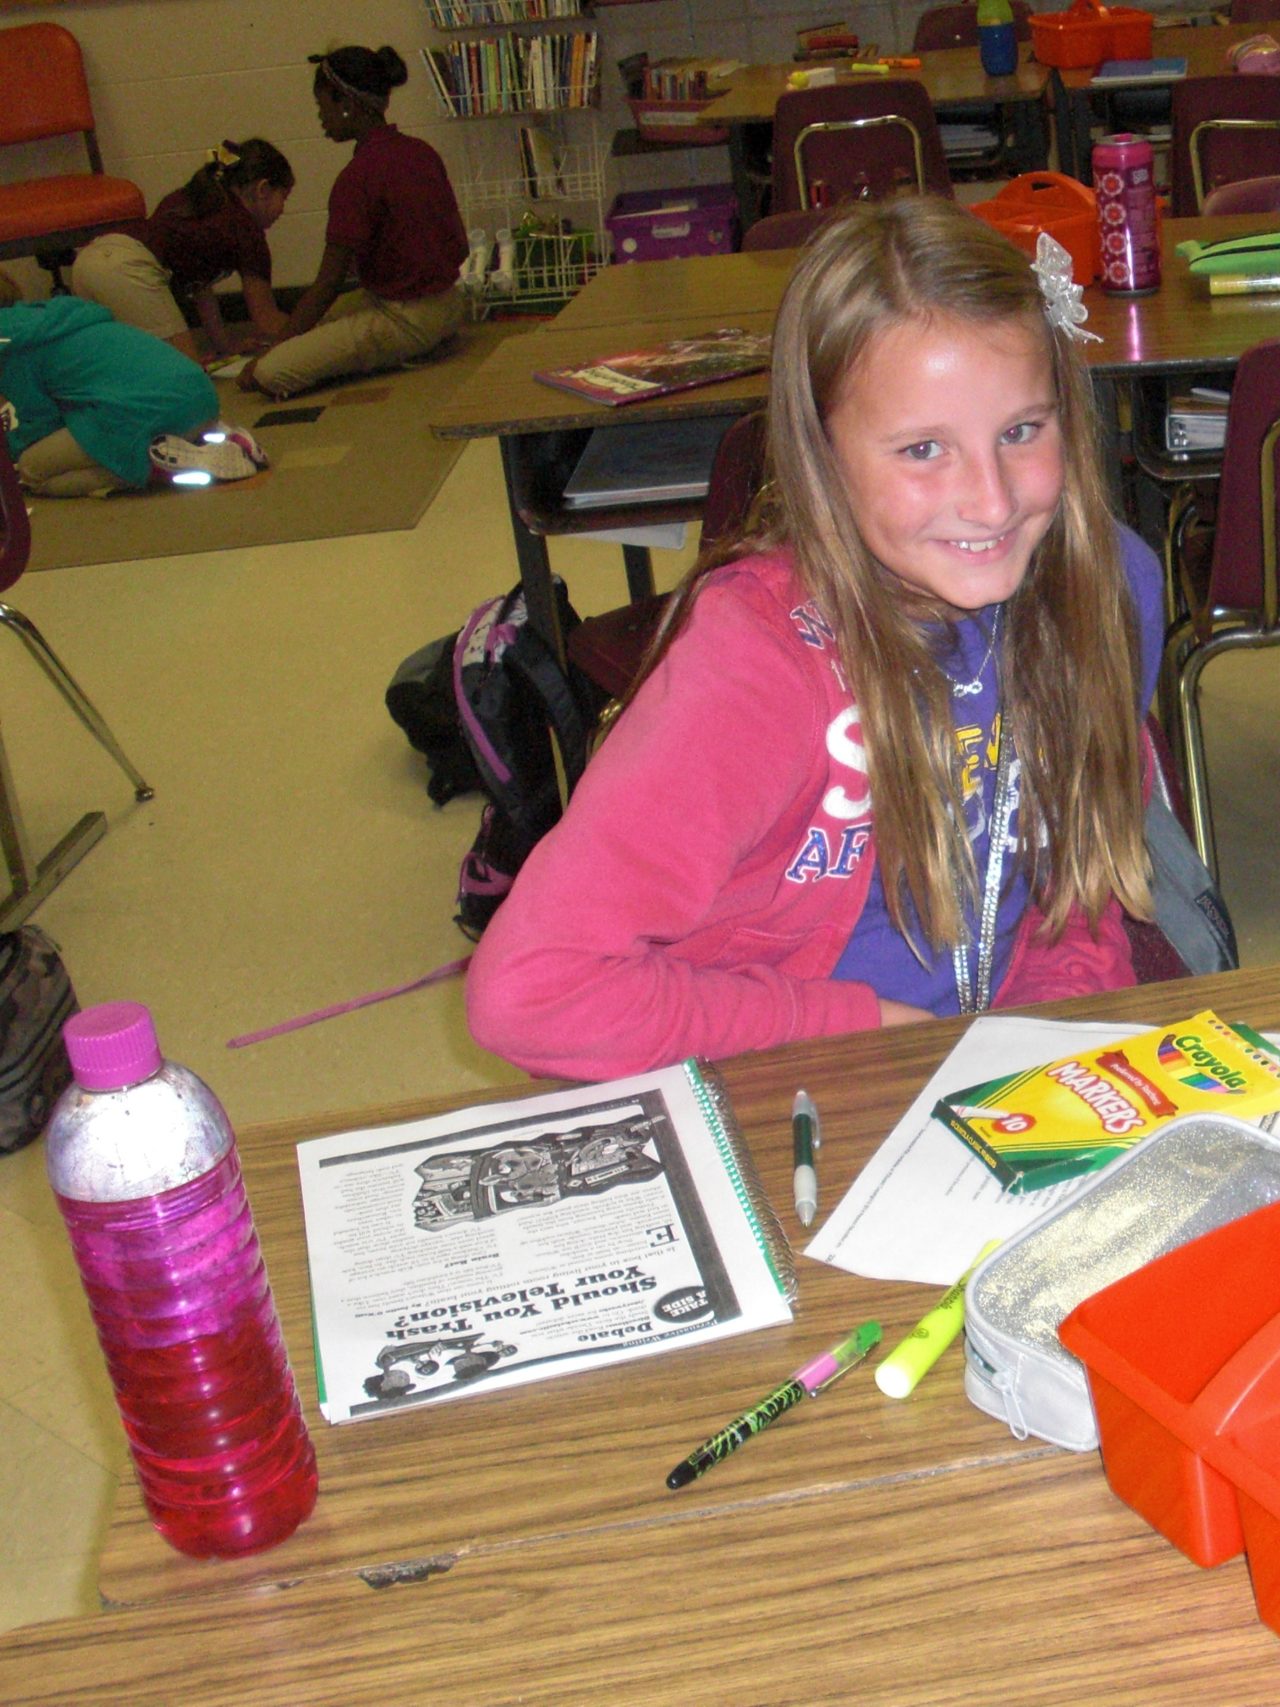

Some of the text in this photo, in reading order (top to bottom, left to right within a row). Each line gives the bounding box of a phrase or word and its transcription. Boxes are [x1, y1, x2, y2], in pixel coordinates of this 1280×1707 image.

[1175, 1035, 1247, 1088] Crayola
[1045, 1060, 1146, 1134] MARKERS
[1001, 1116, 1028, 1132] 10
[574, 1264, 646, 1288] Your
[385, 1275, 658, 1342] Should You Trash
[393, 1281, 566, 1328] Television?
[662, 1296, 695, 1312] SIDE
[669, 1299, 709, 1317] TAKE
[577, 1321, 653, 1342] Debate
